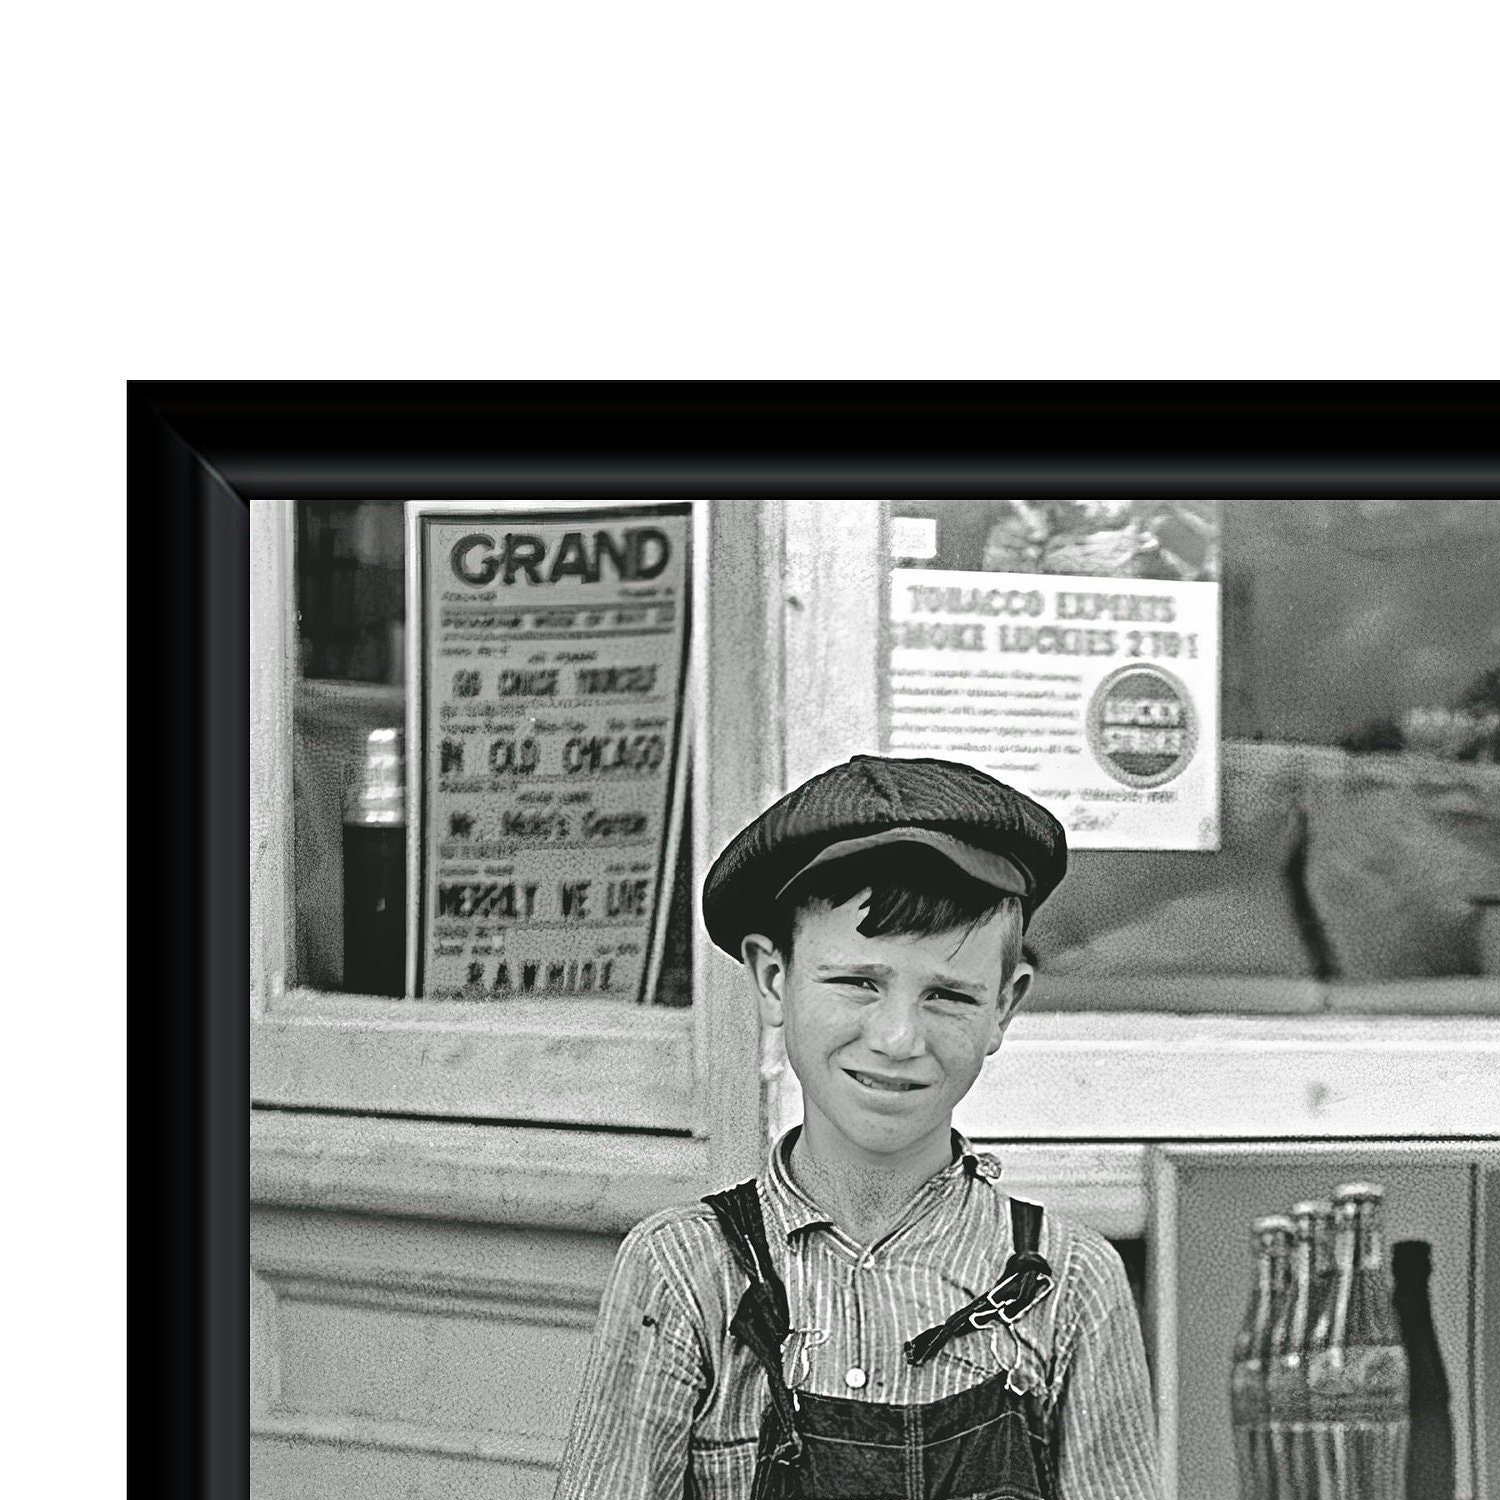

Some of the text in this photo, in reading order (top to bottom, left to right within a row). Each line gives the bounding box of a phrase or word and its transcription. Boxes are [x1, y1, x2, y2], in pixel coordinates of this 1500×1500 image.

[450, 525, 672, 589] GRAND
[907, 585, 1177, 622] TOBACCO EXPERTS
[998, 624, 1119, 657] LUCKIES
[1126, 629, 1144, 658] 2
[1148, 631, 1180, 659] TO
[1104, 699, 1181, 725] LUCKY
[438, 734, 666, 775] IN OLD CHICAGO
[437, 878, 649, 919] MERRILY WE LIVE
